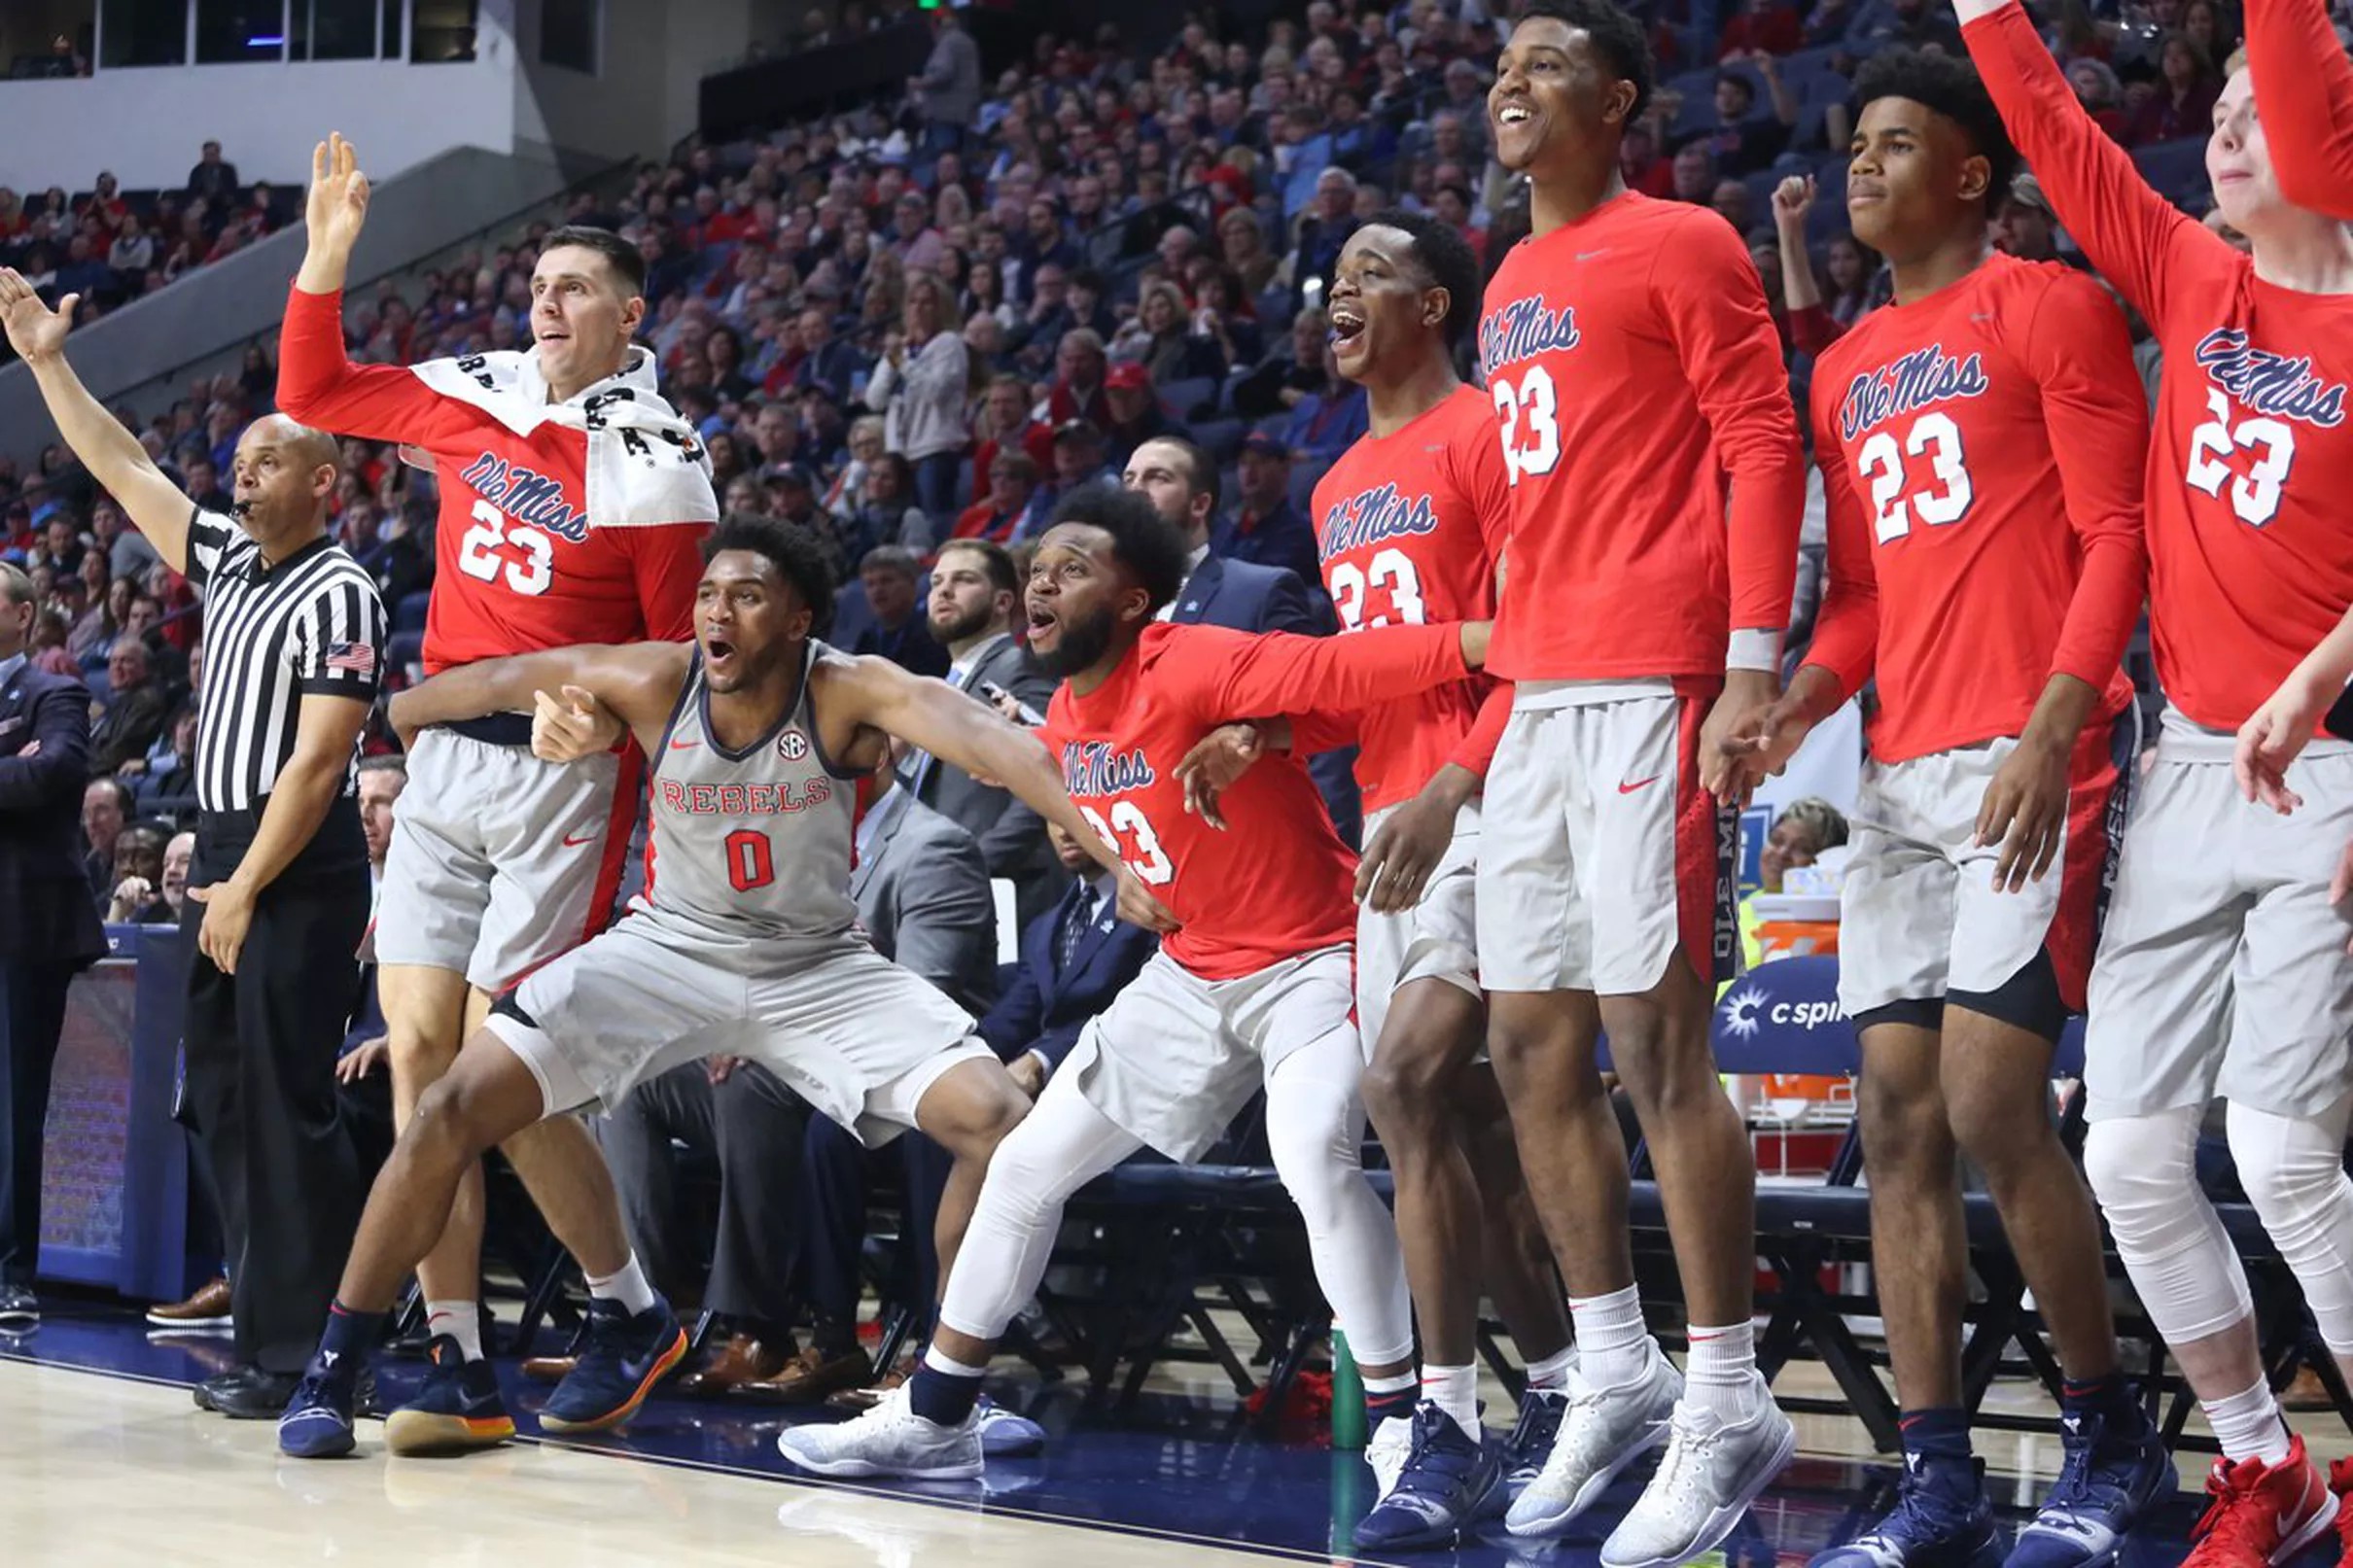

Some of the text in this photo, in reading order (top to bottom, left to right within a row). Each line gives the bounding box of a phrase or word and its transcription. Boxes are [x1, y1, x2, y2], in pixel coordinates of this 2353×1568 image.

[1503, 293, 1580, 363] Miss
[1493, 366, 1562, 486] 23
[1841, 343, 1988, 441] Ole Miss
[2239, 349, 2347, 428] Miss
[461, 450, 589, 542] Ole Miss
[1858, 411, 1976, 545] 23
[2186, 386, 2295, 528] 23
[459, 499, 554, 596] 23
[1318, 482, 1437, 567] Ole Miss
[1330, 548, 1426, 635] 23
[779, 732, 806, 759] SEC
[1084, 741, 1155, 796] Miss
[662, 776, 830, 815] REBELS
[724, 829, 774, 892] 0
[1714, 877, 1736, 958] OLE
